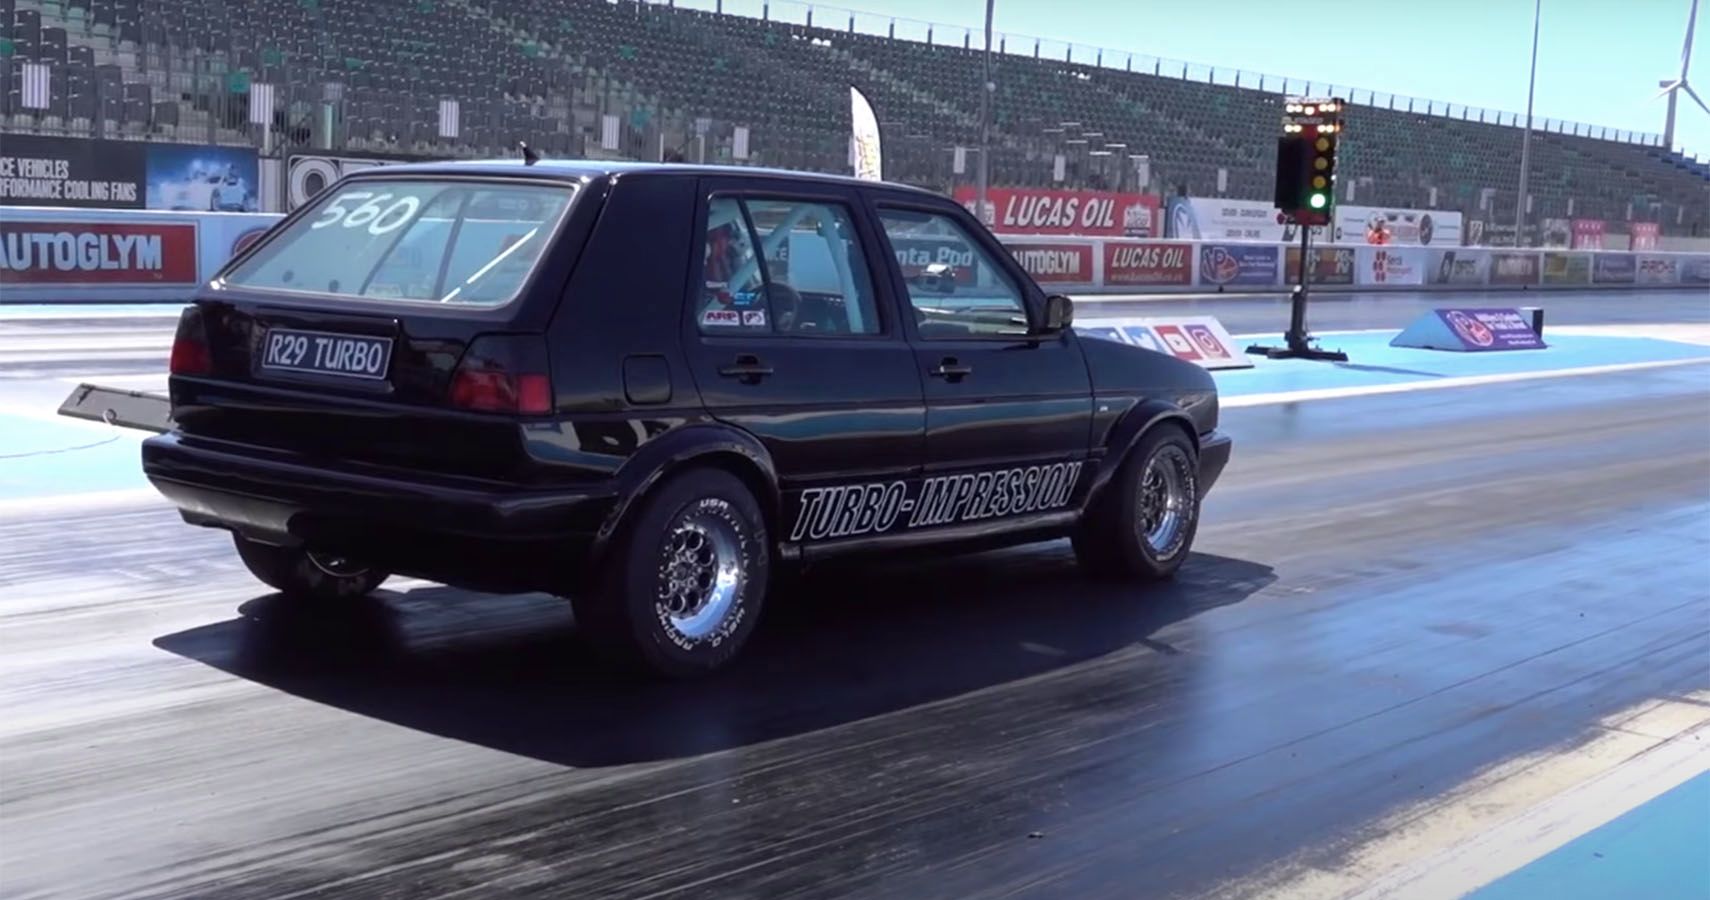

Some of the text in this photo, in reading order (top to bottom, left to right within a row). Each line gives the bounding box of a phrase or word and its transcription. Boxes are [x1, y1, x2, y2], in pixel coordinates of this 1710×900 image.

[17, 158, 69, 179] VEHICLES
[64, 180, 109, 201] COOLING
[111, 182, 137, 202] FANS
[311, 191, 420, 235] 560
[1003, 194, 1079, 228] LUCAS
[1081, 198, 1115, 228] OIL
[936, 246, 972, 266] Pod
[1112, 248, 1184, 268] LUCAS OIL
[706, 312, 736, 320] ARP
[268, 336, 384, 374] R29 TURBO
[700, 498, 728, 509] USA
[788, 461, 1080, 541] TURBO-IMPRESSION
